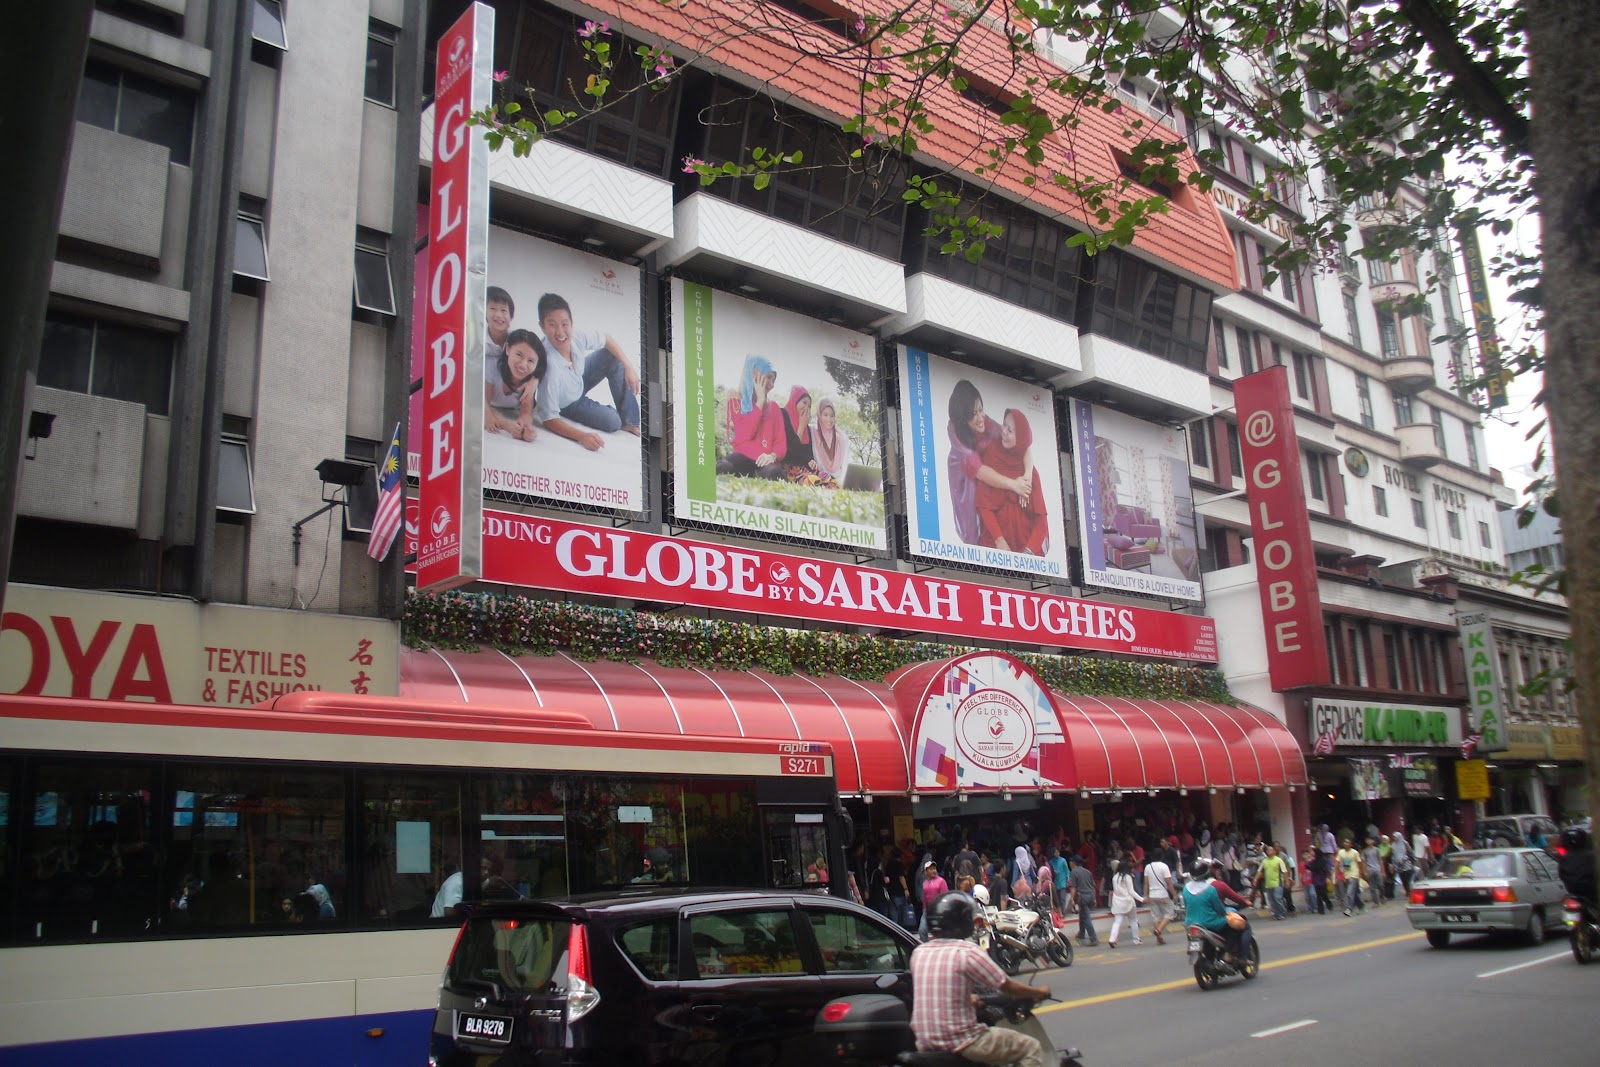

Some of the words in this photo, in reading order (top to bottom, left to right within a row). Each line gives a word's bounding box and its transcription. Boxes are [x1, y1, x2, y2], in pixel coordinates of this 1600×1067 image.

[427, 98, 465, 481] GLOBE
[695, 327, 704, 377] MUSLIM
[914, 355, 924, 406] MODERN
[919, 411, 928, 462] LADIES
[921, 467, 930, 503] WEAR
[1081, 407, 1098, 532] FURNISHINGS
[1383, 464, 1420, 494] HOTEL
[502, 471, 553, 495] TOGETHER,
[554, 479, 582, 498] STAYS
[584, 484, 629, 505] TOGETHER
[690, 502, 769, 529] ERATKAN
[774, 516, 875, 546] SILATURAHIM
[422, 533, 457, 554] GLOBE
[920, 540, 965, 559] DAKAPAN
[967, 547, 984, 564] MU,
[985, 551, 1011, 567] KASIH
[1013, 555, 1046, 573] SAYANG
[1048, 561, 1060, 575] KU
[418, 556, 436, 570] SARAH
[555, 529, 764, 599] GLOBE
[768, 585, 794, 601] BY
[798, 562, 964, 622] SARAH
[979, 588, 1137, 643] HUGHES
[1090, 570, 1136, 587] TRANQUILITY
[1137, 578, 1144, 589] IS
[1145, 580, 1151, 590] A
[1152, 581, 1176, 594] LOVELY
[1177, 586, 1195, 597] HOME
[204, 646, 307, 678] TEXTILES
[202, 678, 216, 703] &
[963, 697, 978, 712] FEEL
[977, 693, 989, 701] THE
[989, 693, 1023, 715] DIFFERENCE
[1468, 631, 1498, 745] KAMDAR
[788, 757, 818, 773] S271
[972, 752, 994, 767] KUALA
[995, 753, 1021, 768] LUMPUR
[465, 1017, 483, 1034] BLR
[483, 1018, 505, 1036] 9278
